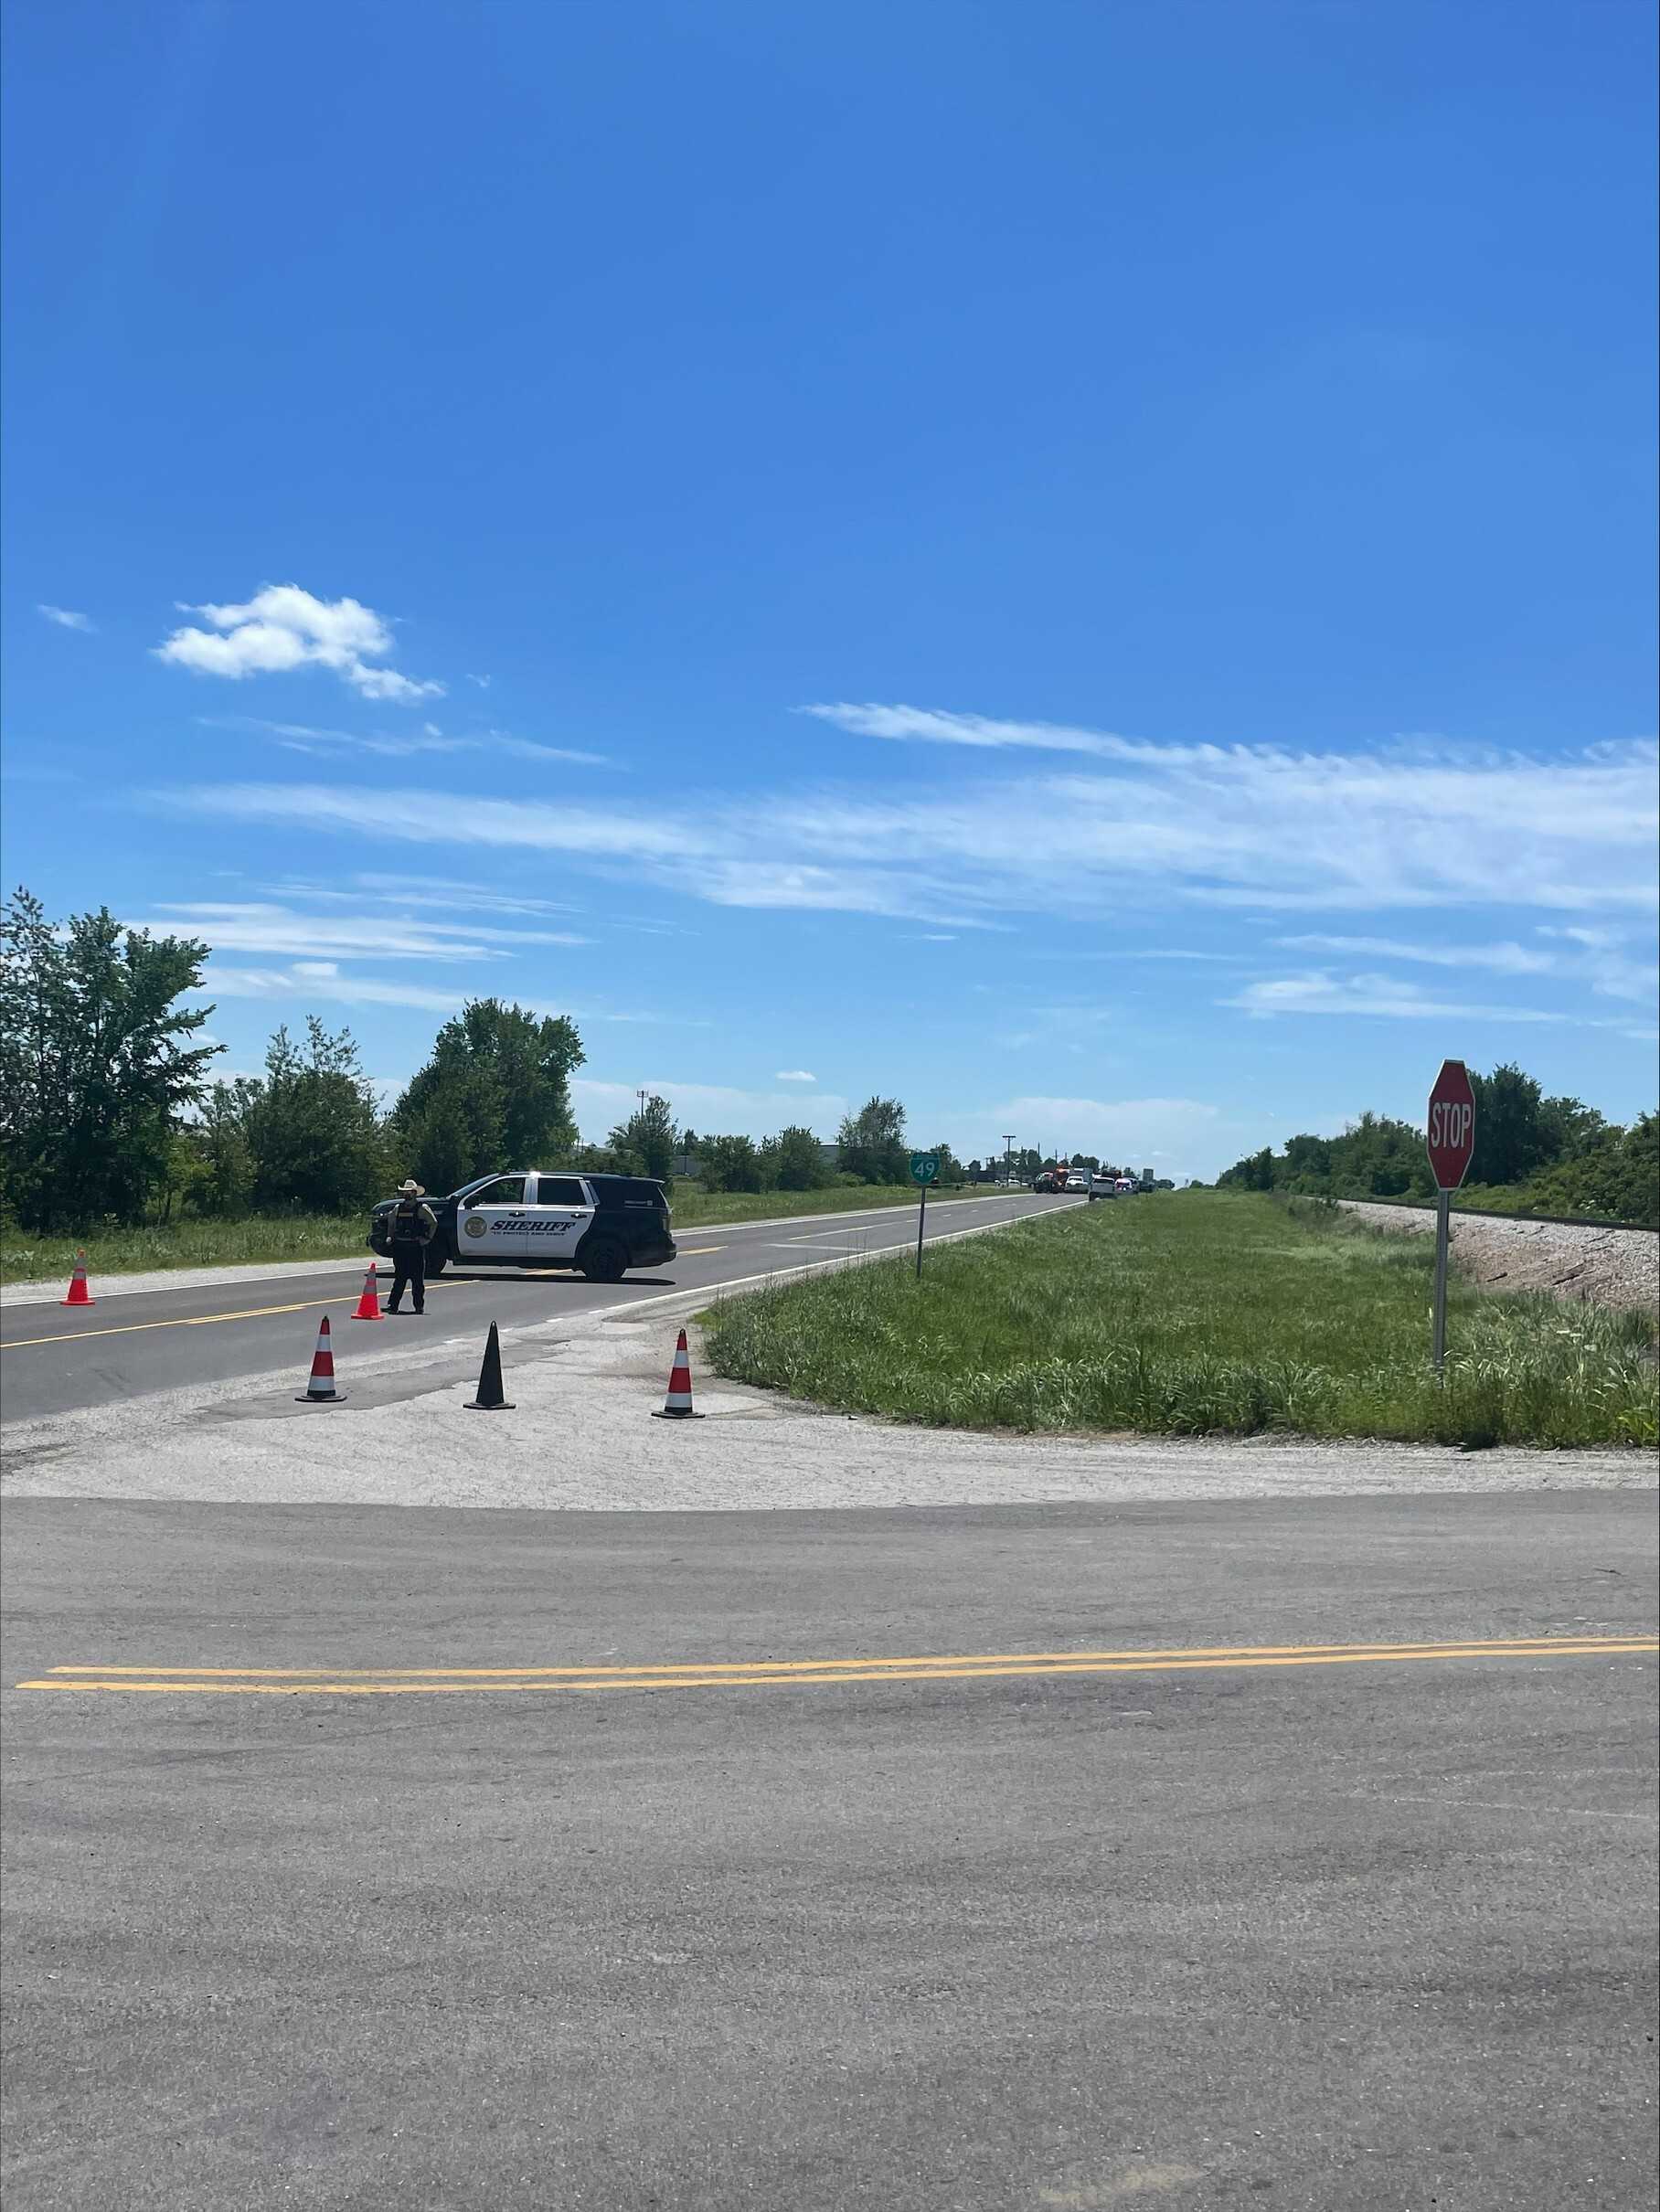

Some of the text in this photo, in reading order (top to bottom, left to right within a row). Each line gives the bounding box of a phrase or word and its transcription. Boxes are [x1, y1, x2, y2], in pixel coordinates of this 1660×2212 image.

[1431, 1102, 1471, 1148] STOP
[914, 1162, 935, 1177] 49
[490, 1220, 576, 1232] SHERIFF
